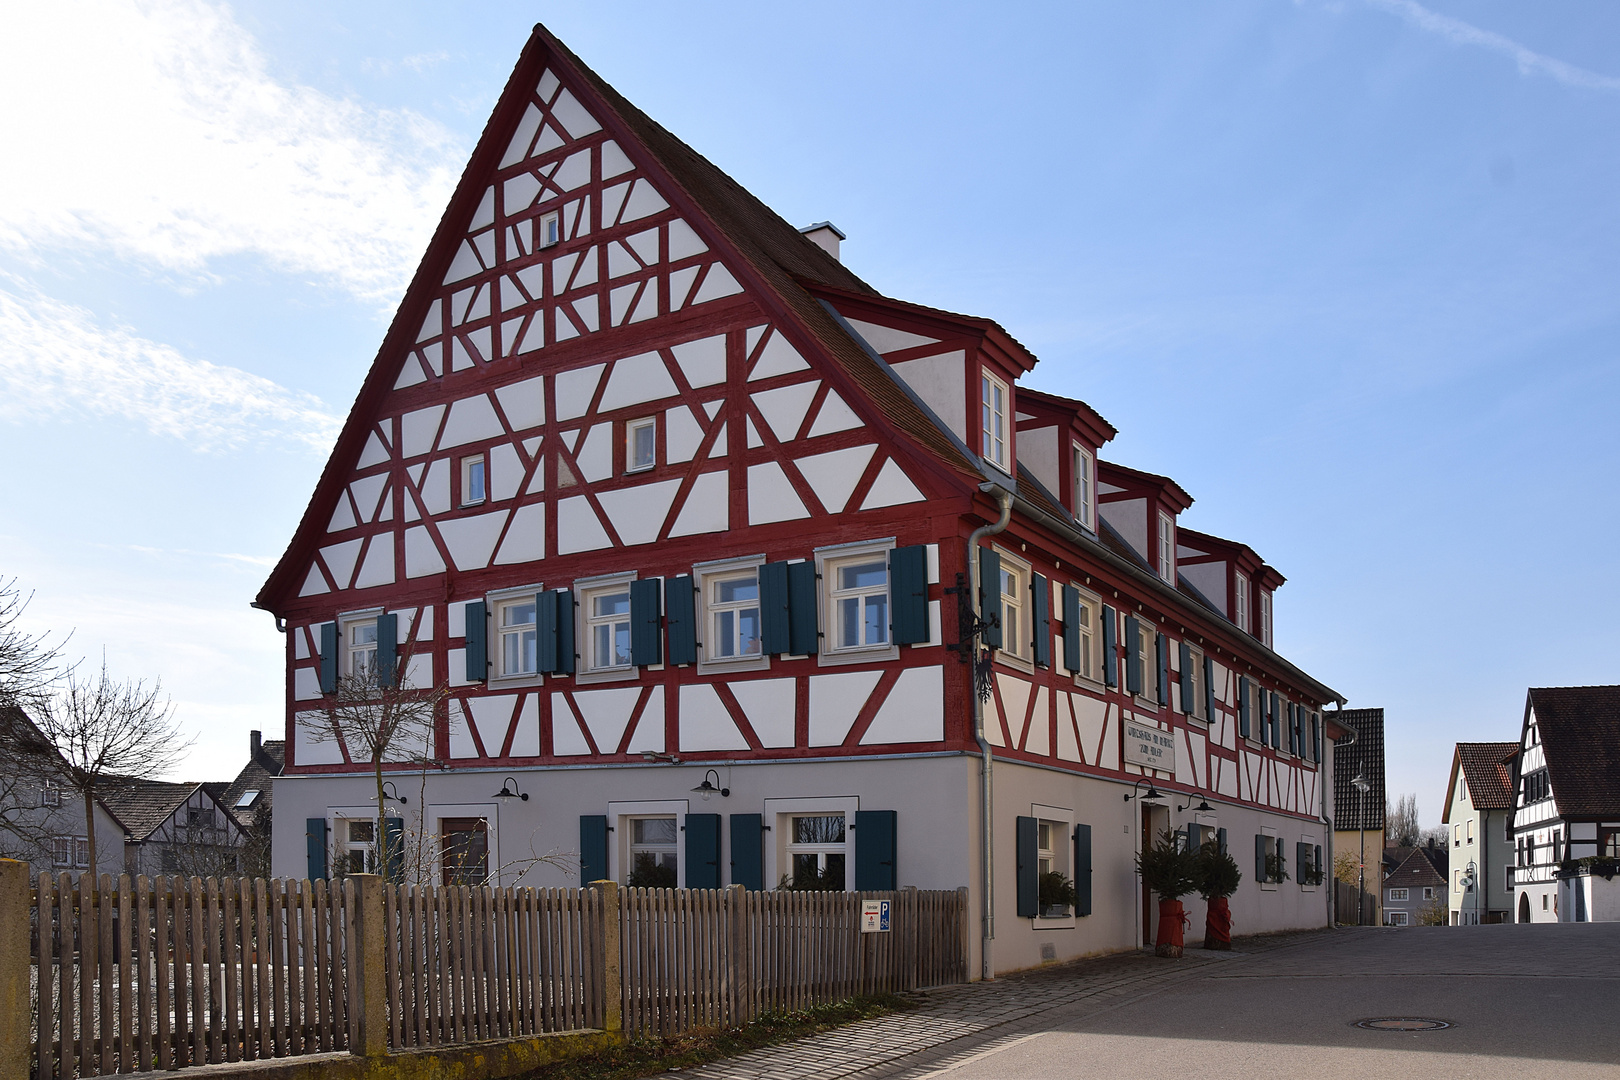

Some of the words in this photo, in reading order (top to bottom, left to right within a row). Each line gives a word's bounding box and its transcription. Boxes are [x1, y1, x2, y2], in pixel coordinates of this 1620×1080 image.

[1139, 744, 1148, 754] ZUM
[1150, 746, 1163, 758] ADLER
[882, 903, 888, 915] P
